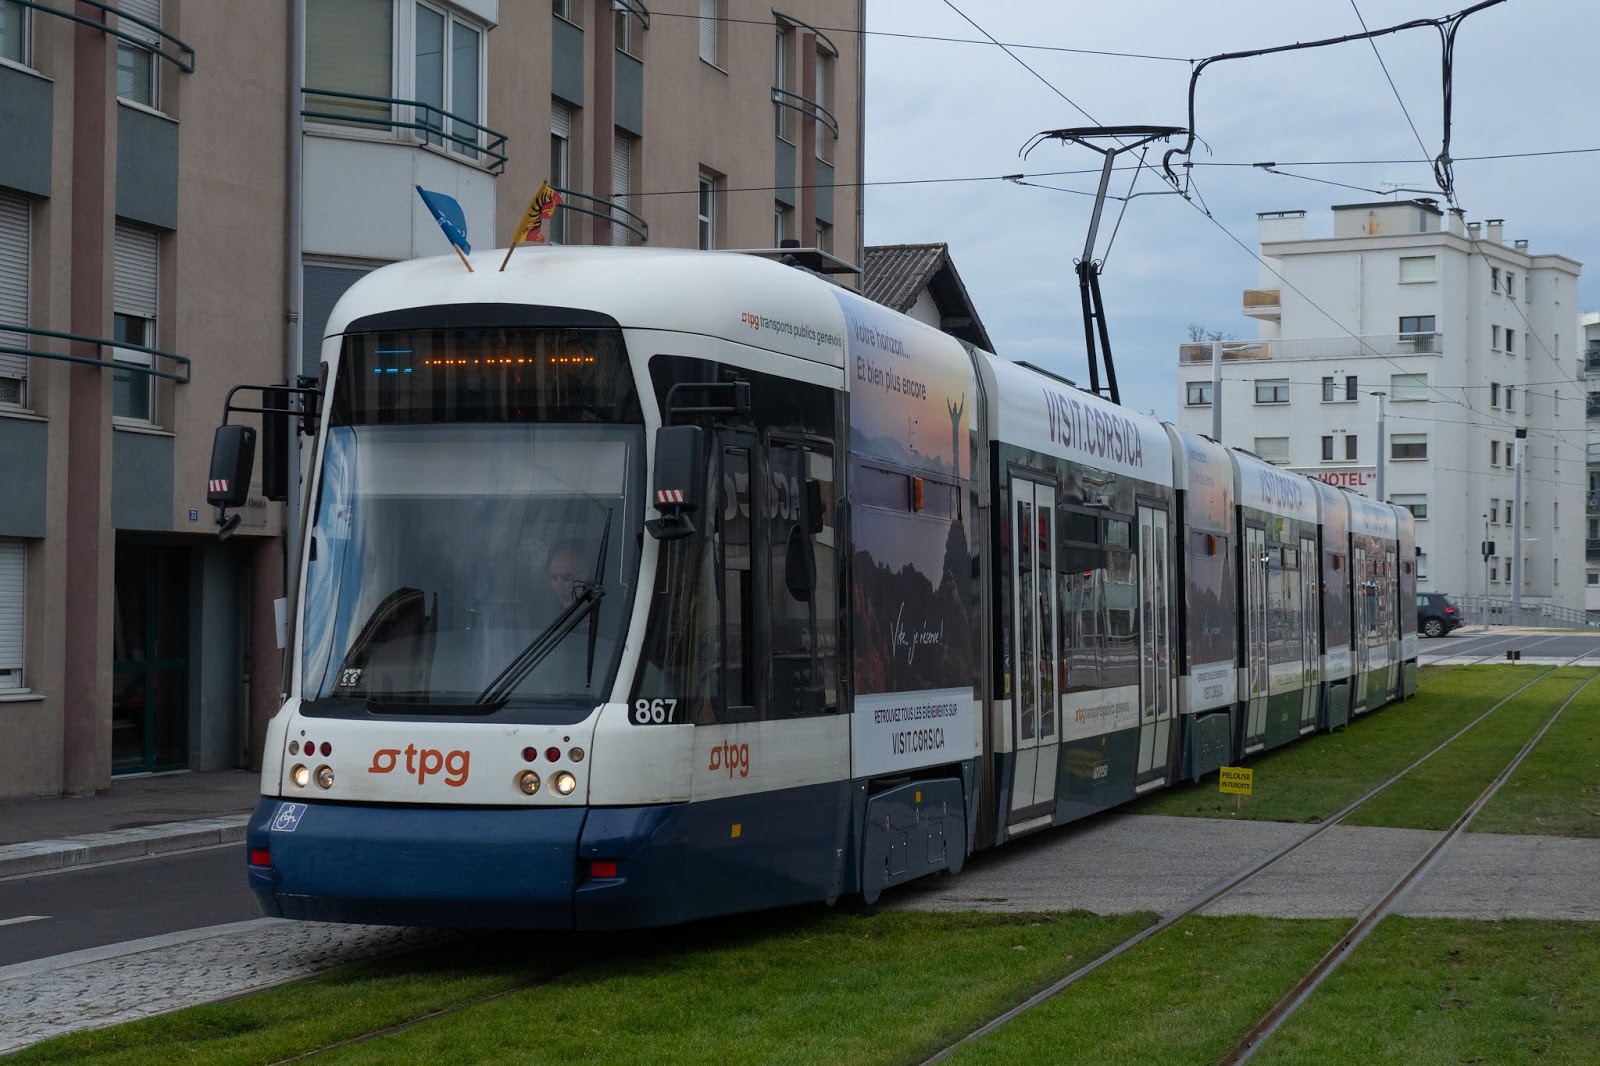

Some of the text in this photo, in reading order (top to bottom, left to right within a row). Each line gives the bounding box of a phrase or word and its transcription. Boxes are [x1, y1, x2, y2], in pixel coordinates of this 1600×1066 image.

[760, 314, 793, 336] transports
[793, 324, 816, 342] publics
[816, 332, 842, 347] genevois
[852, 316, 875, 348] Votre
[856, 355, 927, 401] Et bien plus encore
[1042, 387, 1143, 468] VISIT.CORSICA
[634, 698, 678, 725] 867
[874, 708, 901, 725] RETROUVEZ
[901, 706, 913, 721] TOUS
[914, 705, 922, 721] LES
[949, 702, 958, 717] SUR
[891, 727, 945, 755] VISIT.CORSICA
[1221, 771, 1251, 780] PELOUSE
[1221, 781, 1251, 790] INTERDITE
